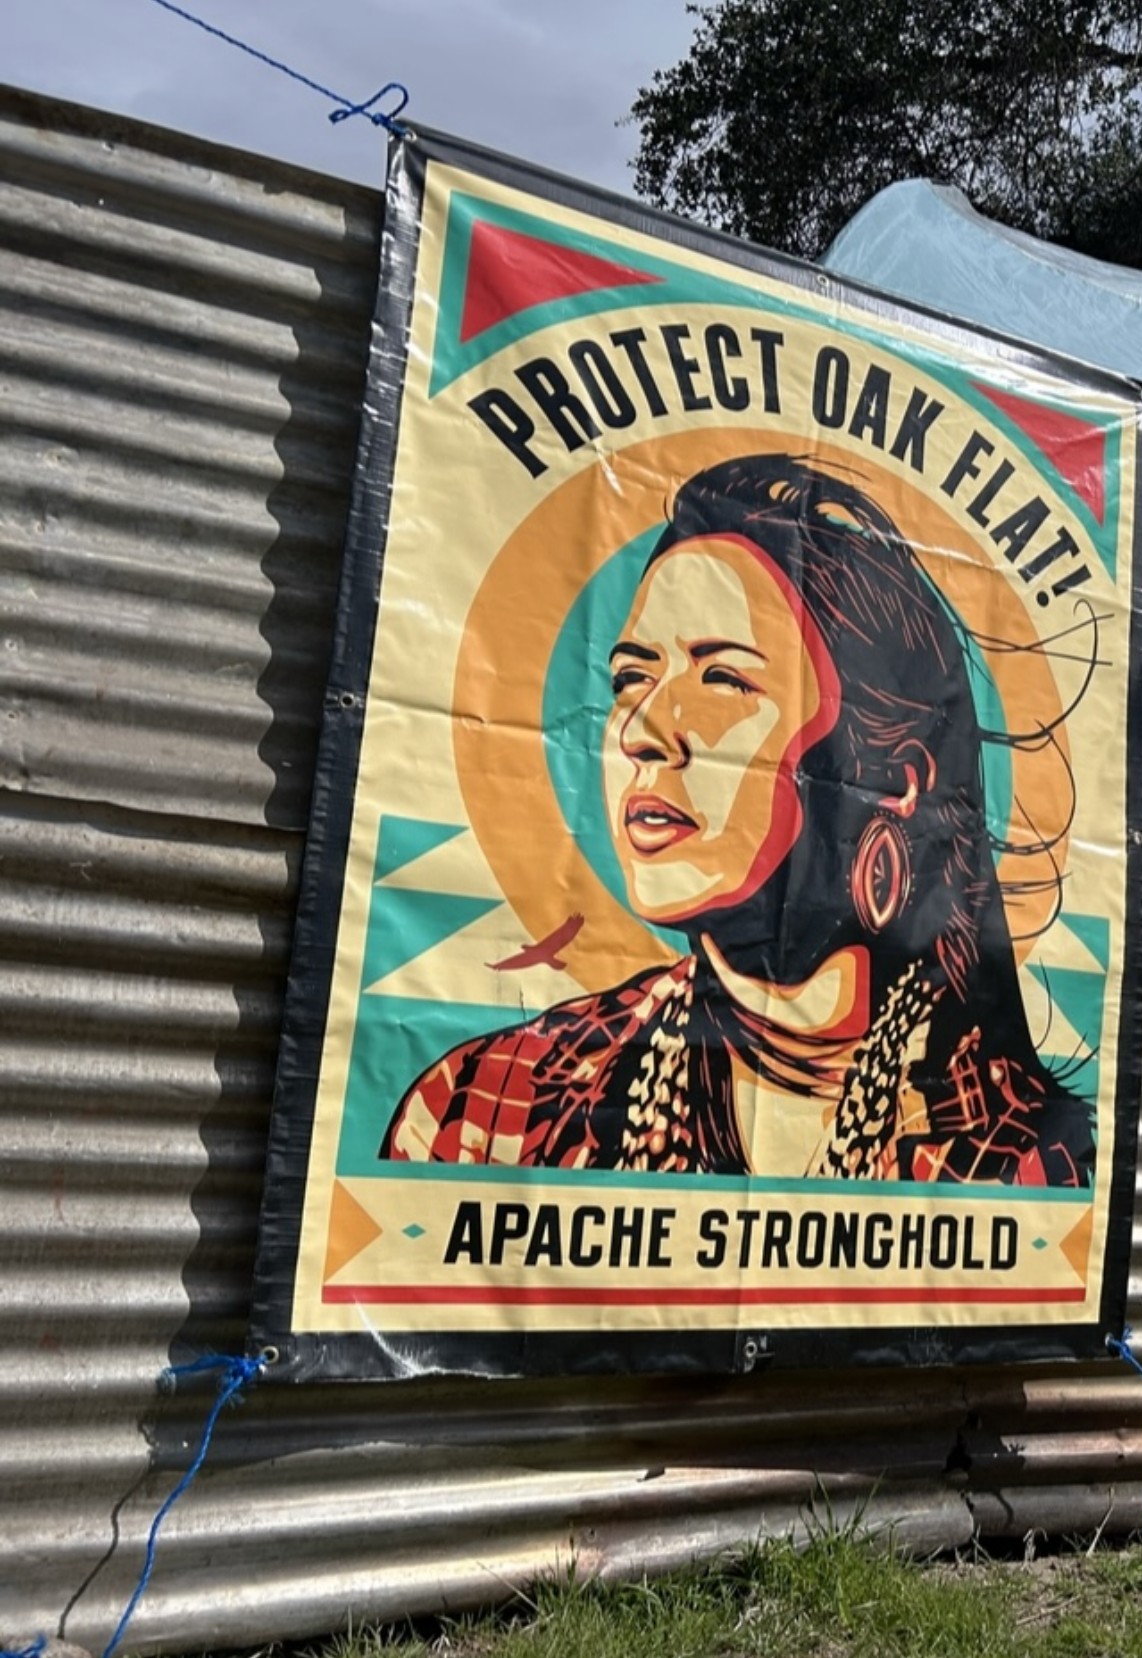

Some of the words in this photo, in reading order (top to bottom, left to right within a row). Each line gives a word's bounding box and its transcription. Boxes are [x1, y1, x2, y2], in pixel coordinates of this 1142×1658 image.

[467, 322, 784, 478] PROTECT
[812, 345, 945, 473] OAK
[940, 429, 1092, 607] FLAT!
[443, 1201, 675, 1267] APACHE
[696, 1207, 1018, 1271] STRONGHOLD
